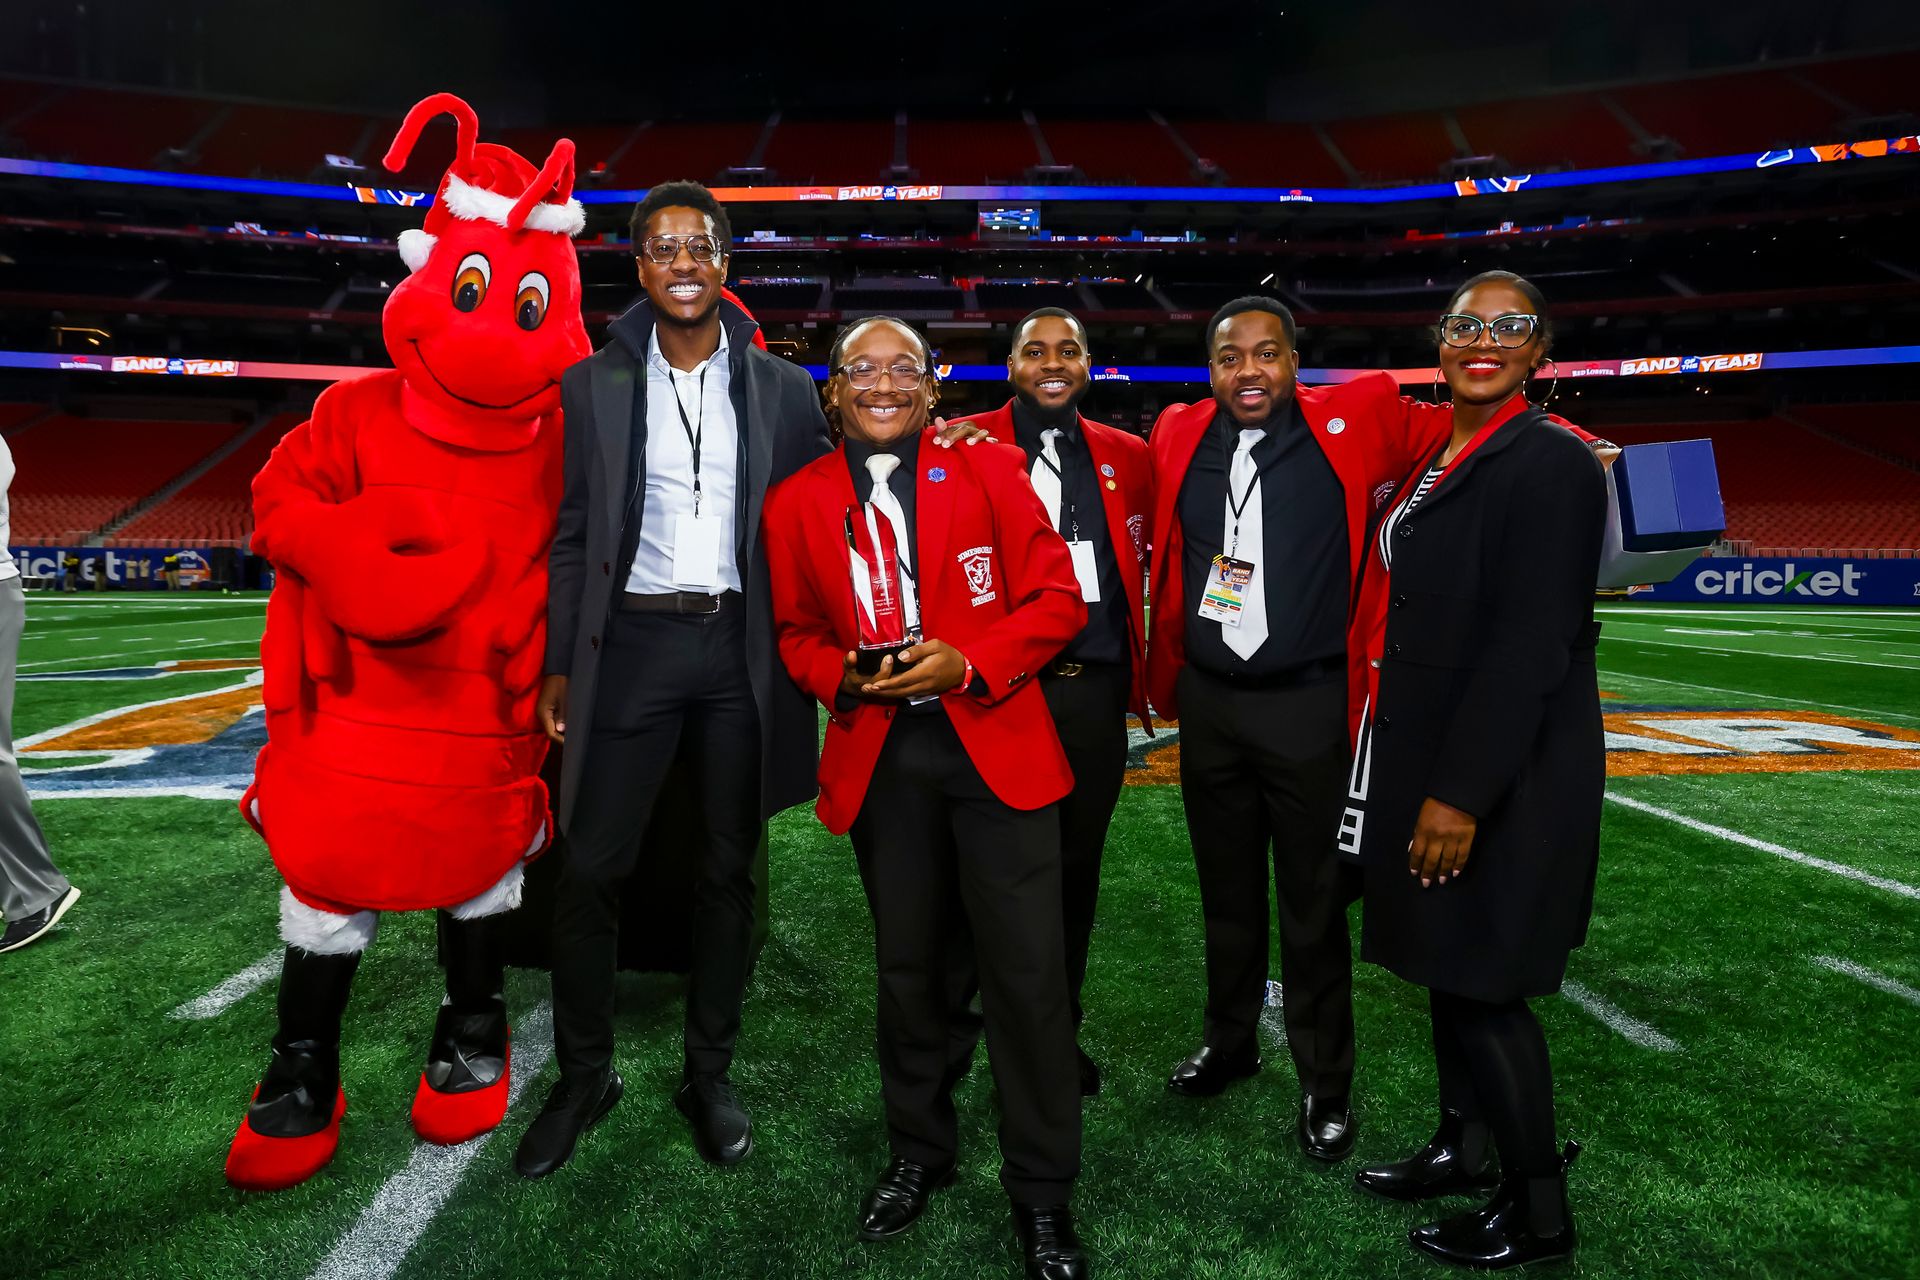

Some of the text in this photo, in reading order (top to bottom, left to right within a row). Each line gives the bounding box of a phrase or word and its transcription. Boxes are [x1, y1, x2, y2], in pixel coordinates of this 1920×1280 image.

[840, 186, 883, 200] BAND
[897, 186, 939, 200] YEAR
[113, 357, 168, 372] BAND
[184, 361, 235, 375] YEAR
[1621, 357, 1680, 375] BAND
[1700, 354, 1757, 372] YEAR
[1695, 563, 1861, 597] cricket
